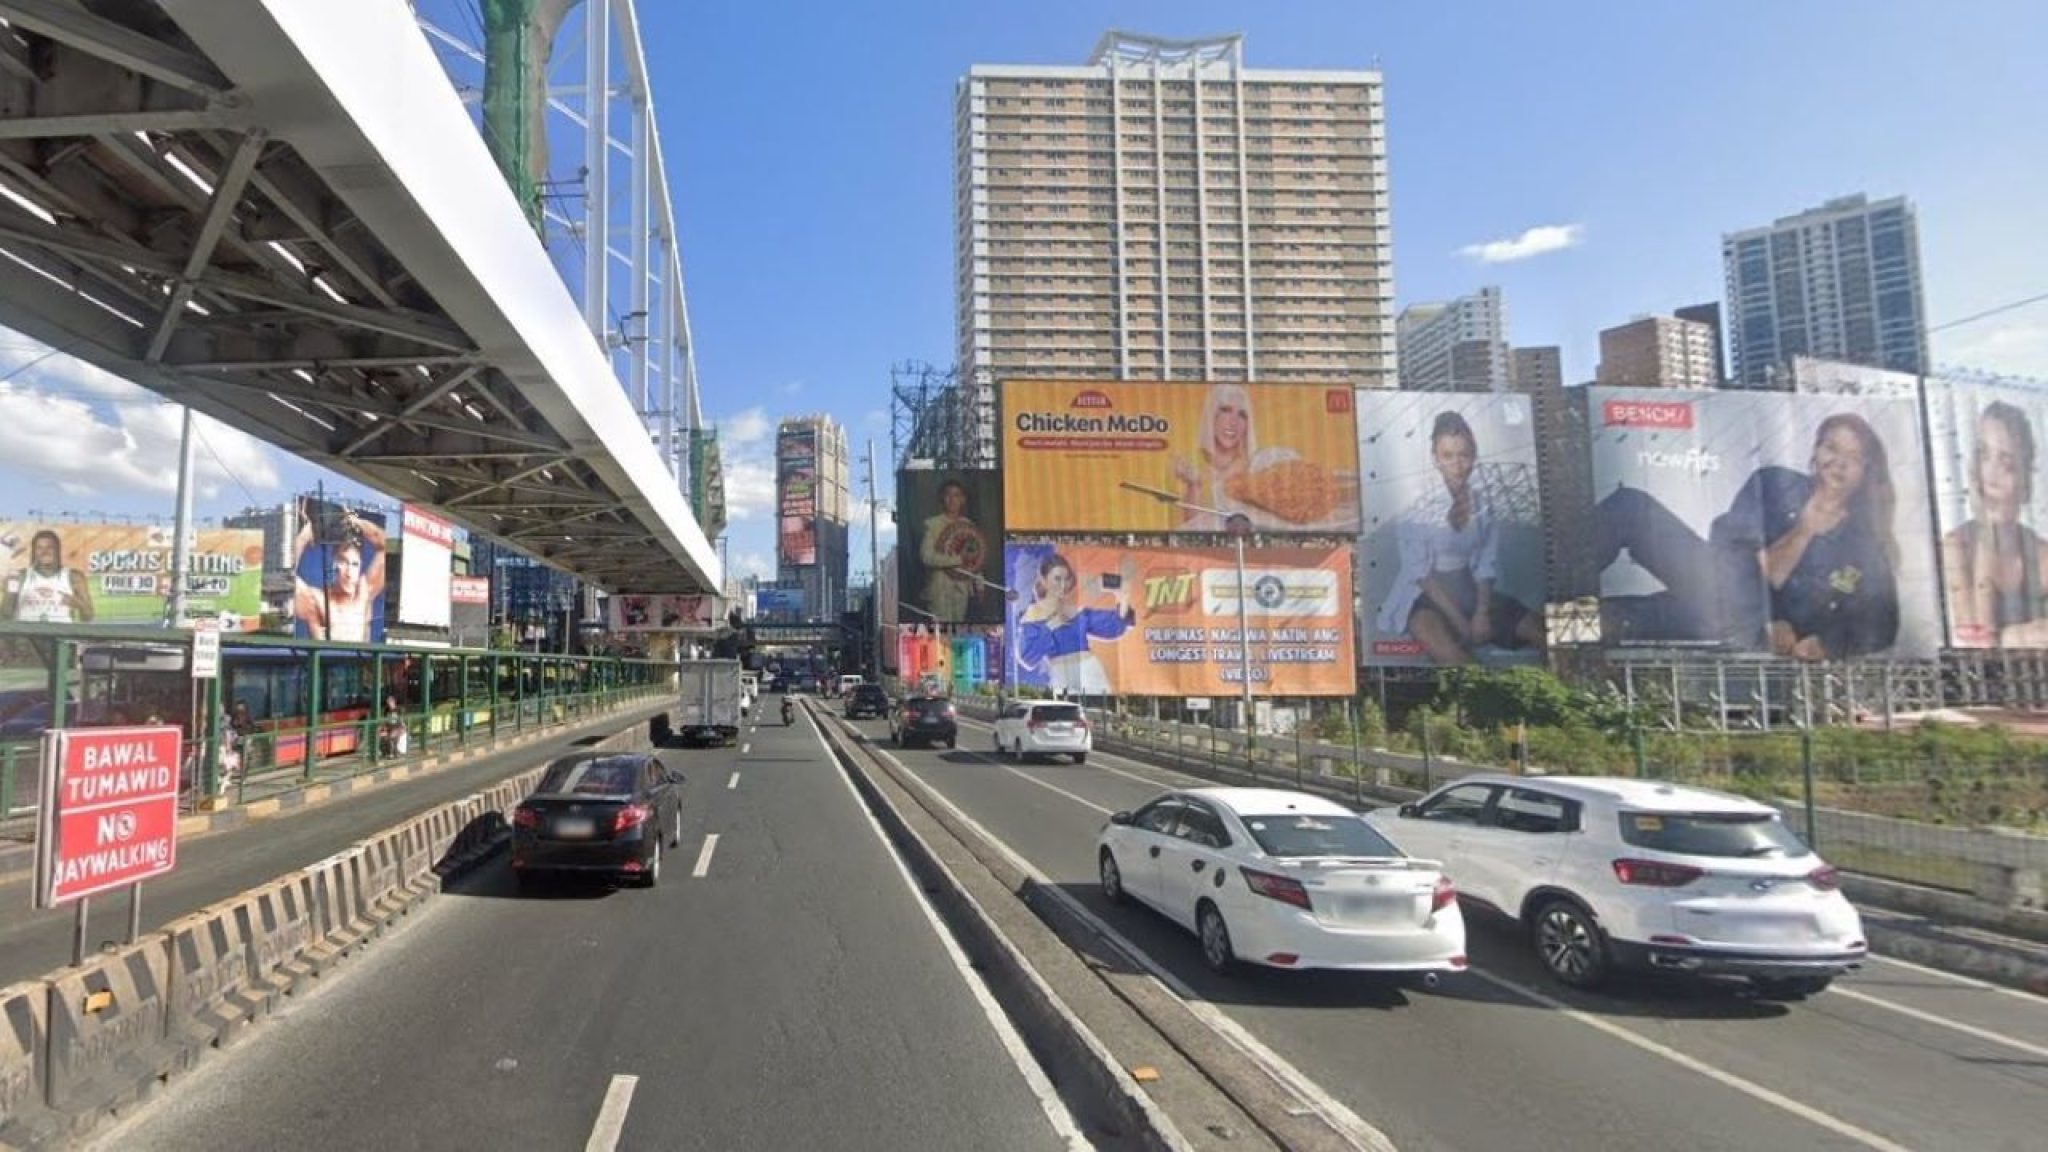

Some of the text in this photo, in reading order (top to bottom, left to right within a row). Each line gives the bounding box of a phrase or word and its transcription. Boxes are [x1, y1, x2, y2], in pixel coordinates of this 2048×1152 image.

[1016, 412, 1169, 433] Chicken McDo
[88, 550, 245, 575] SPORTS TTING
[1143, 573, 1197, 610] TNT
[1210, 628, 1267, 642] NAGWA
[1272, 628, 1308, 643] NATIN
[1313, 628, 1340, 643] ANG
[1151, 648, 1204, 661] LONGEST
[1213, 648, 1256, 661] TRAVL
[83, 741, 158, 770] BAWAL
[67, 767, 170, 801] TUMAWID
[96, 810, 137, 845] NO
